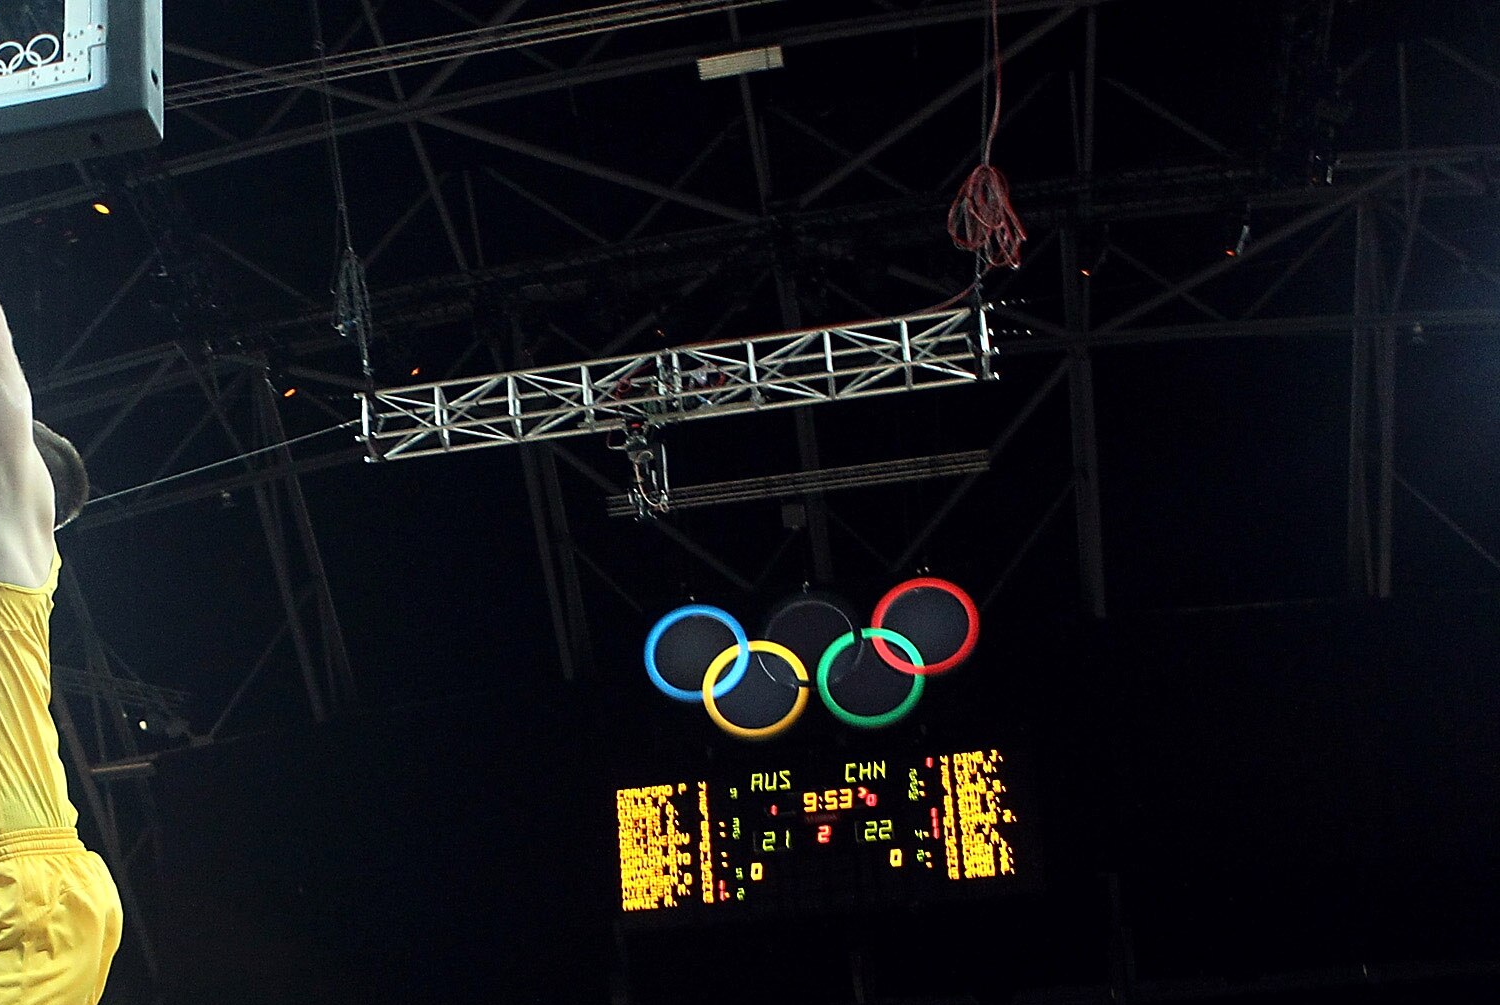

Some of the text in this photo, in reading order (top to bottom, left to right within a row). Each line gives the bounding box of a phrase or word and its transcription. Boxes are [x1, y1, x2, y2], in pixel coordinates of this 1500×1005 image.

[750, 771, 791, 792] AUS
[845, 760, 886, 783] CHN
[803, 788, 853, 812] 9:53
[762, 830, 791, 852] 21
[818, 825, 832, 843] 2
[864, 820, 893, 841] 22
[889, 849, 902, 867] 0
[750, 863, 763, 880] 0
